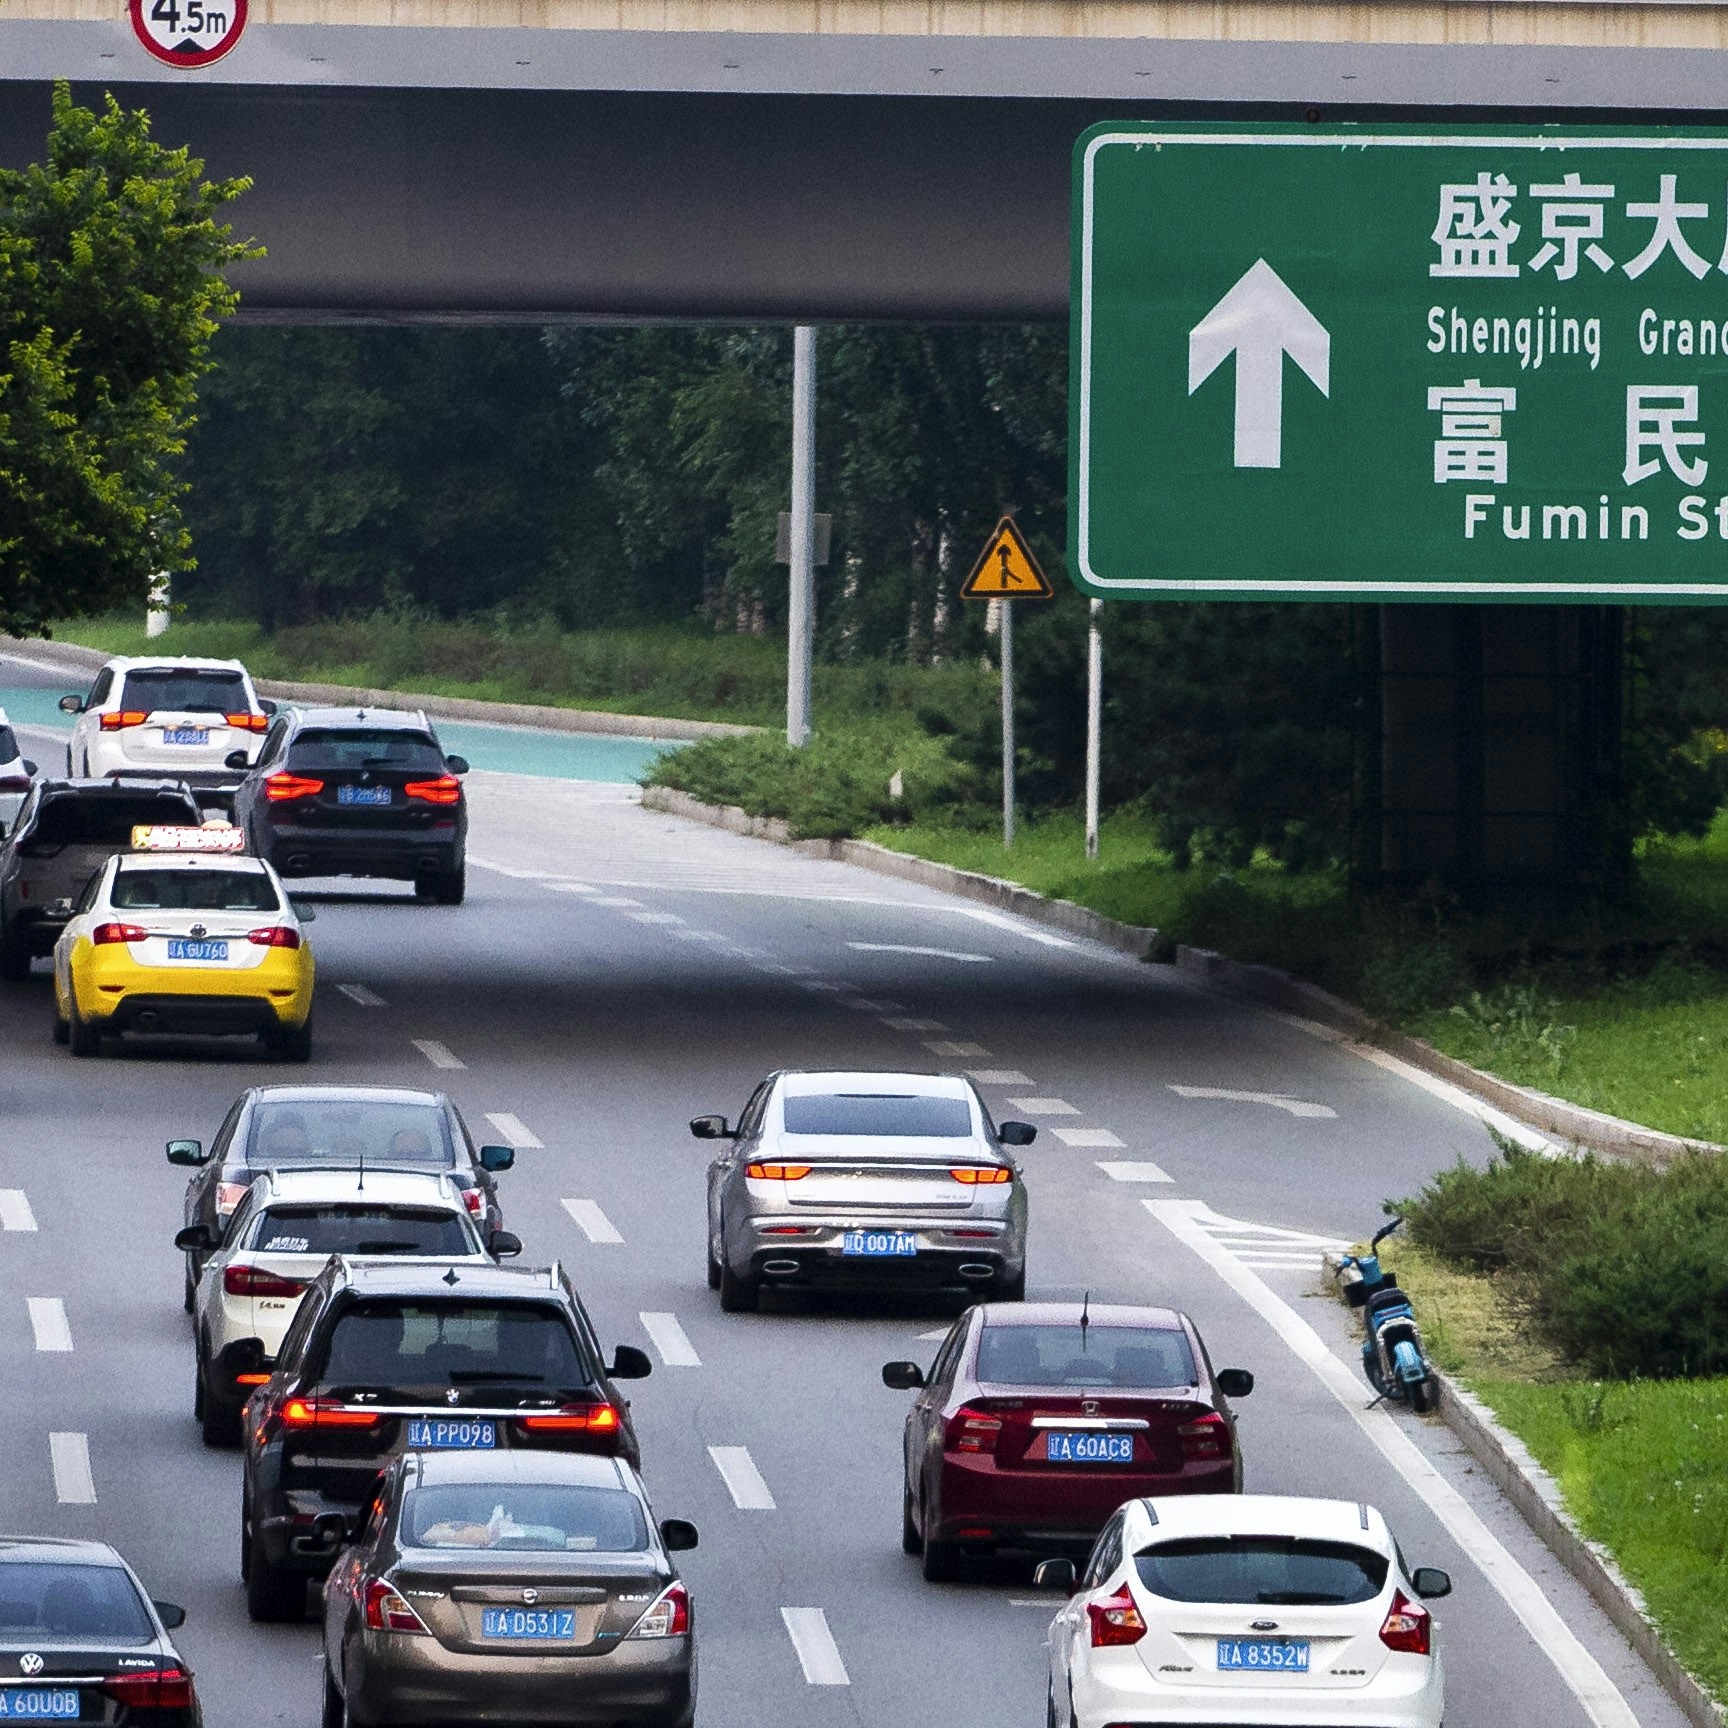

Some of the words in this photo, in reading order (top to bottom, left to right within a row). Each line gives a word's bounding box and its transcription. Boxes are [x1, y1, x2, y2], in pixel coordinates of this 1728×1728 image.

[151, 0, 227, 33] 4.5m
[1426, 306, 1602, 369] Shengjing
[1463, 494, 1649, 541] Fumin
